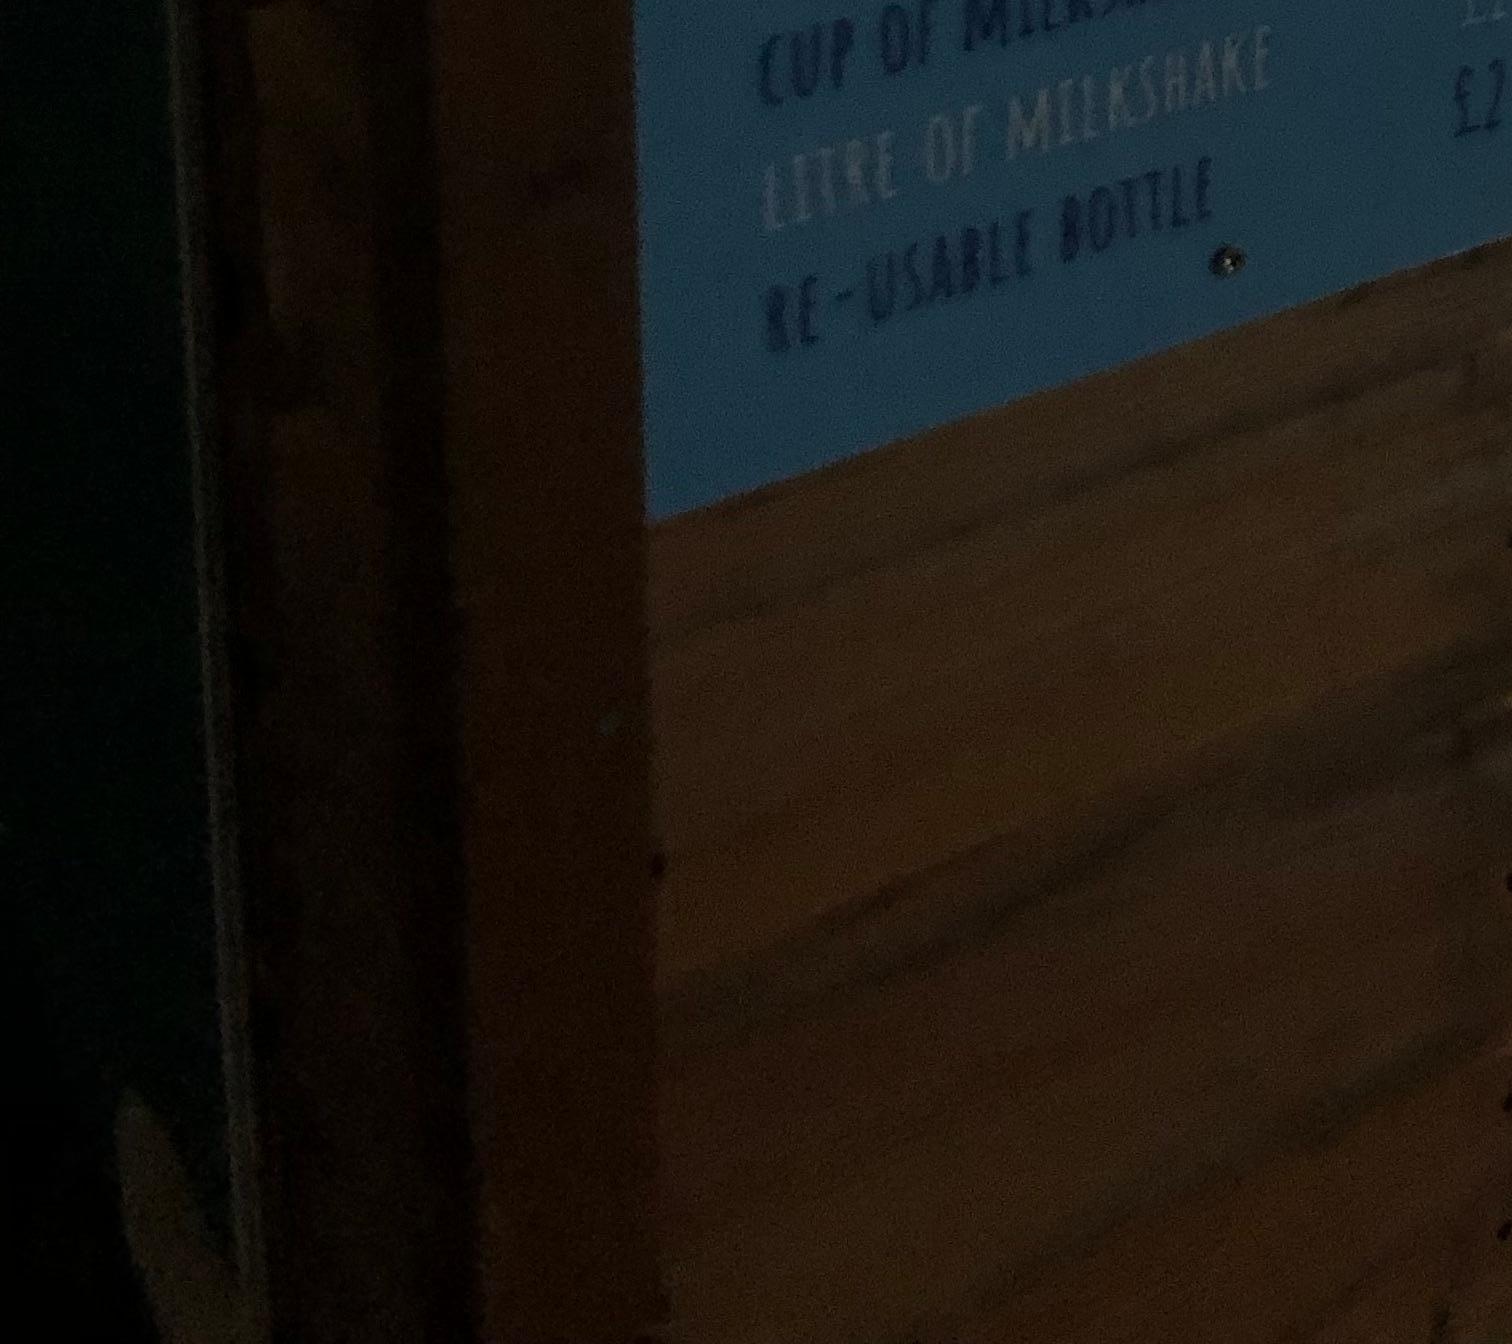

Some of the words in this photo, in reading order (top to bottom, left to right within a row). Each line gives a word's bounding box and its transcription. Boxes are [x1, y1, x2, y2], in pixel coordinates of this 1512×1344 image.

[757, 17, 855, 107] CUP
[762, 129, 896, 231] LITRE
[921, 106, 981, 182] OF
[1006, 24, 1272, 160] MILKSHAKE
[762, 211, 1034, 353] RE-USABLE
[1059, 156, 1213, 263] BOTTLE
